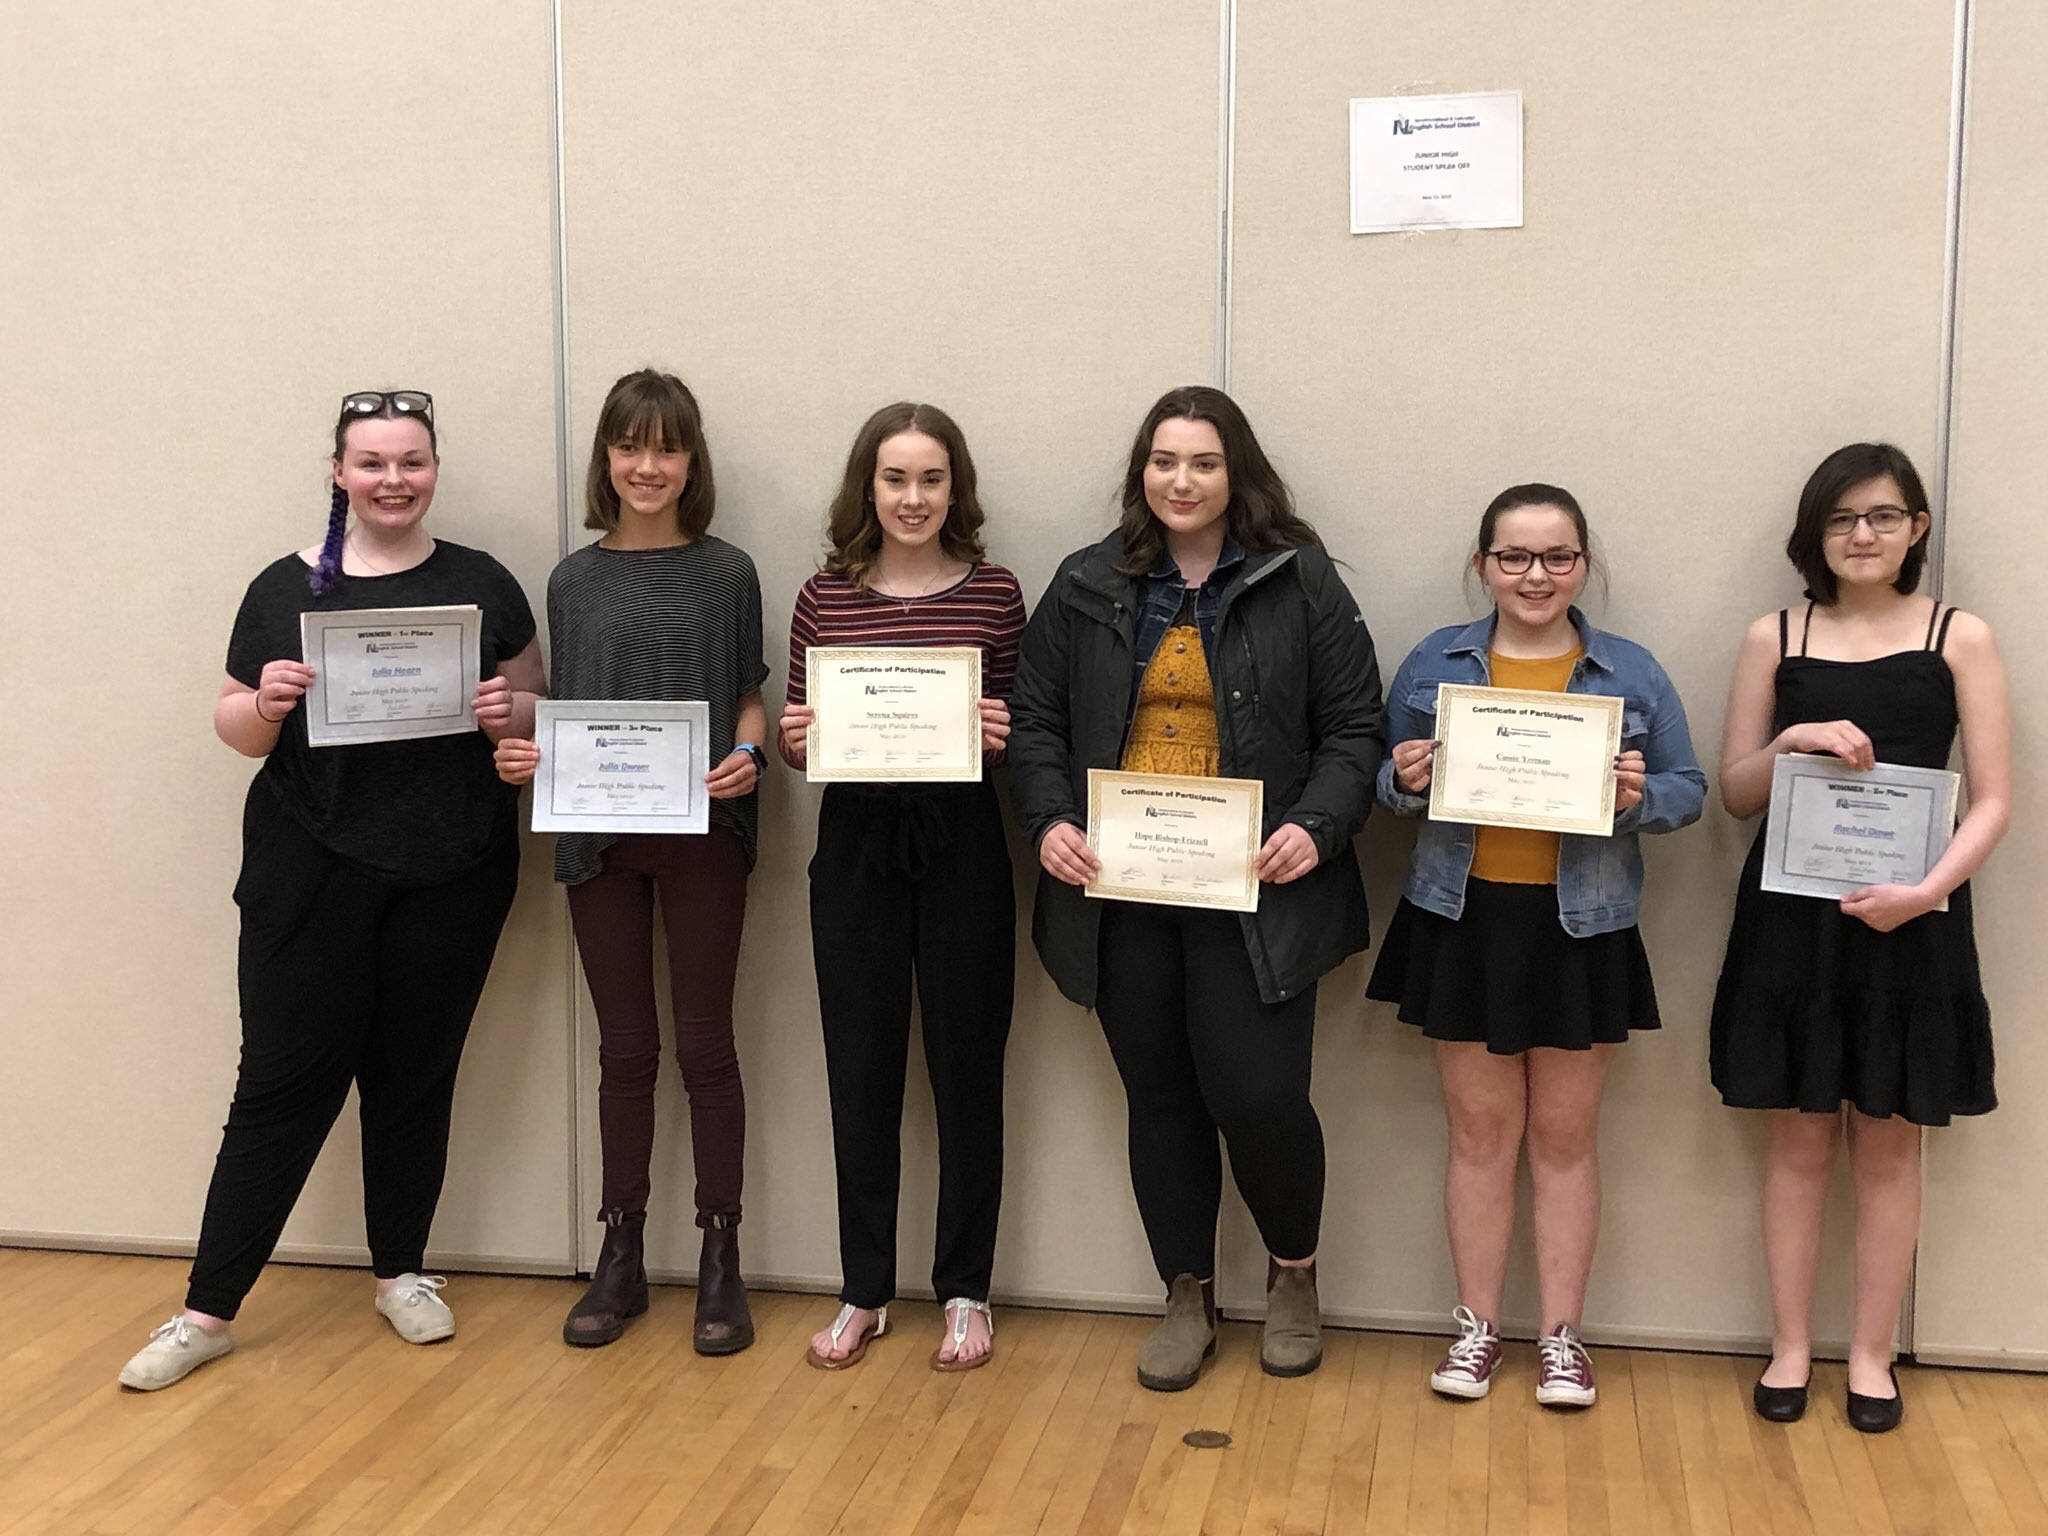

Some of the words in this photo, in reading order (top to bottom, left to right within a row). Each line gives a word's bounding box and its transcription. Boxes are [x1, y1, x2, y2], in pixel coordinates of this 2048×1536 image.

[1457, 162, 1470, 170] OFF
[358, 631, 392, 639] WINNER
[895, 666, 946, 675] Participation
[1472, 706, 1517, 715] Certificate
[1530, 710, 1584, 723] Participation
[1121, 788, 1163, 797] Certificate
[1175, 791, 1227, 804] Participation
